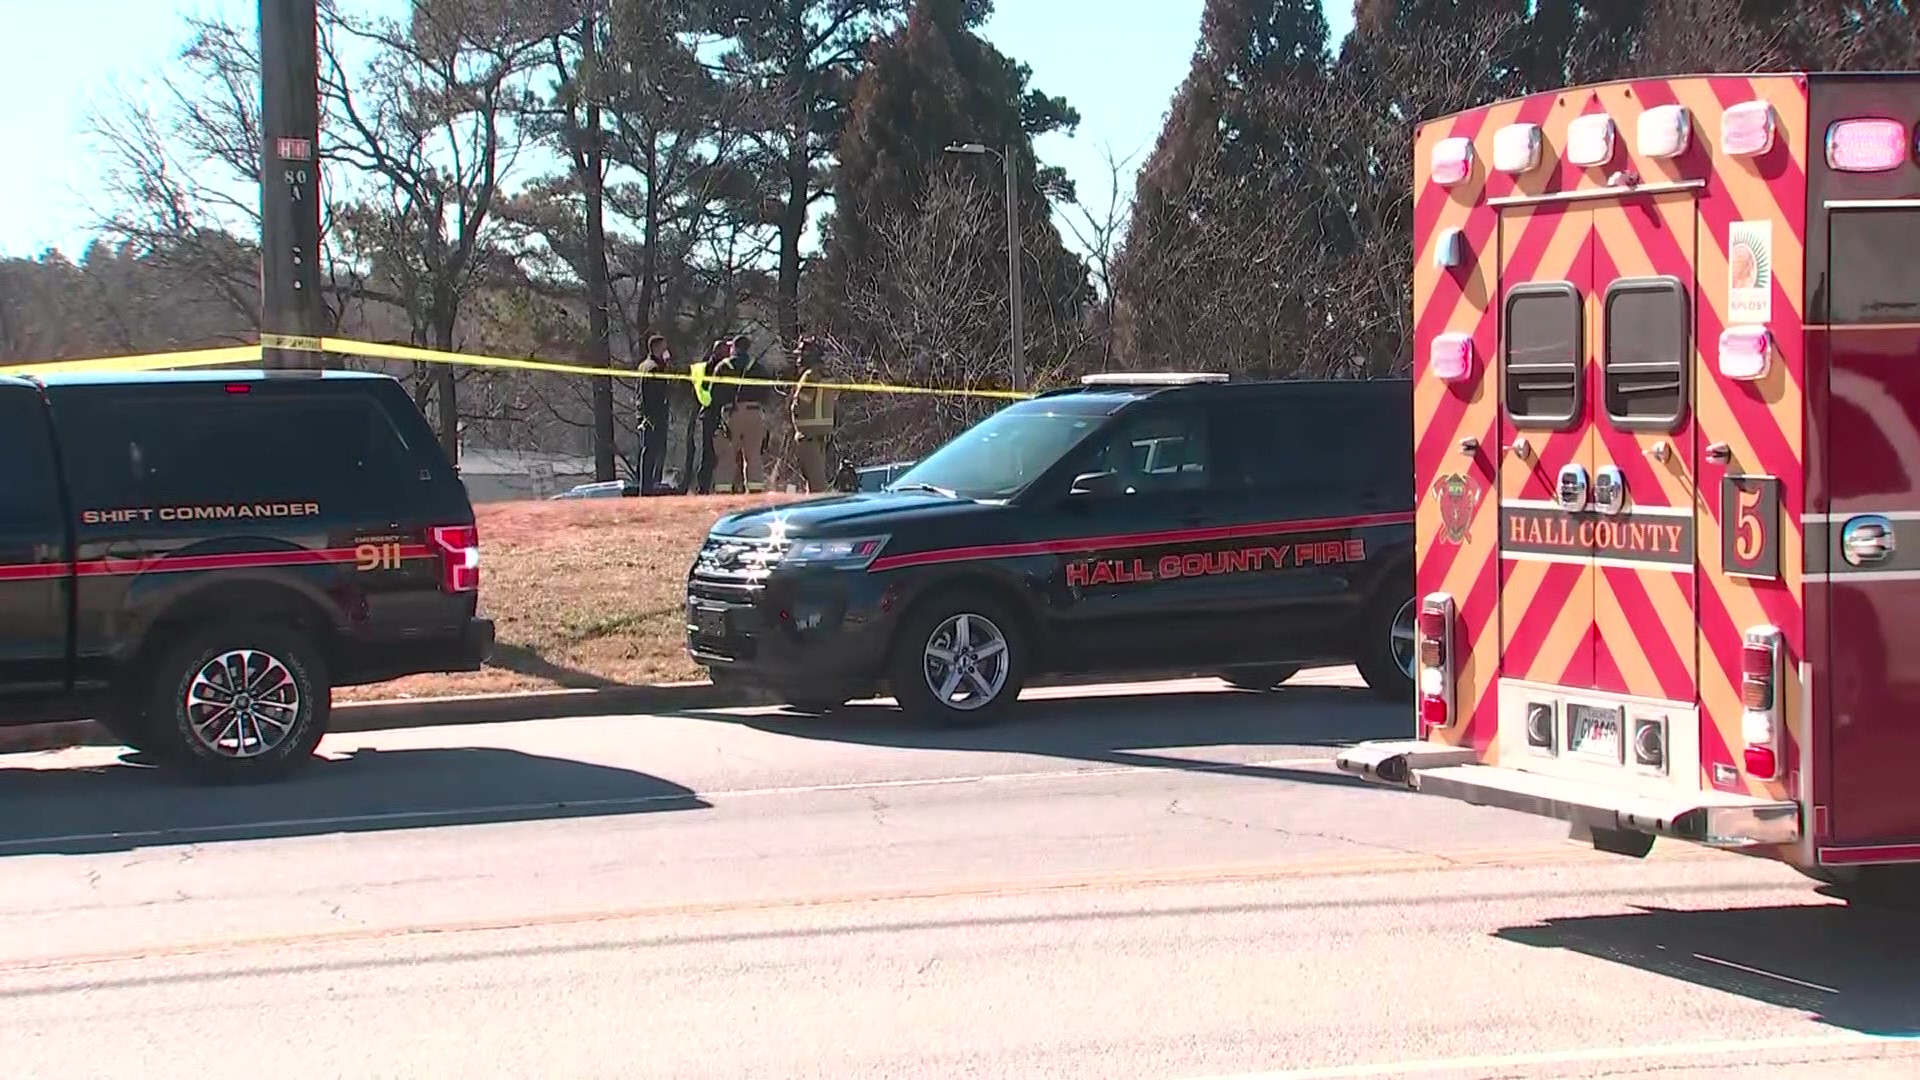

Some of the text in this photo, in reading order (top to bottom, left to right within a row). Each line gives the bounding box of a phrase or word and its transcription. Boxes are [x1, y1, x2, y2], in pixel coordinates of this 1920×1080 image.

[83, 503, 320, 524] SHIFT COMMANDER
[1735, 488, 1764, 565] 5
[1509, 516, 1682, 553] HALL COUNTY
[355, 543, 401, 570] 911
[1066, 538, 1366, 587] HALL COUNTY FIRE
